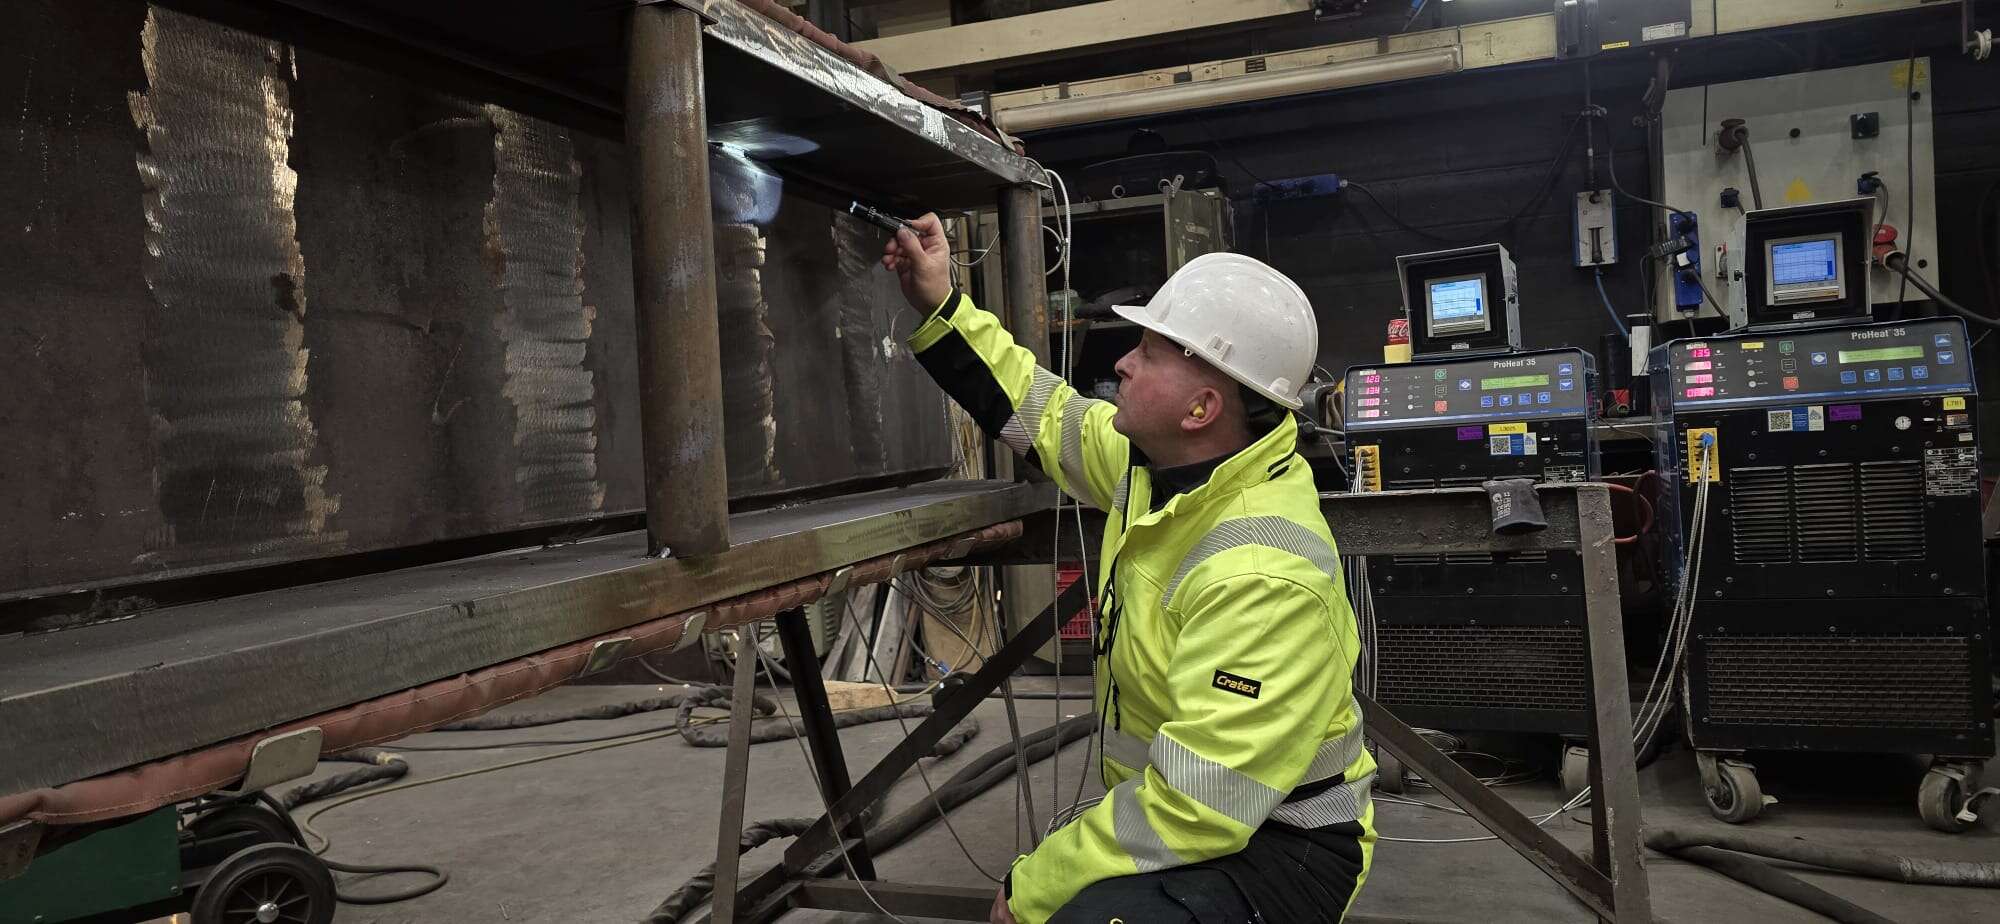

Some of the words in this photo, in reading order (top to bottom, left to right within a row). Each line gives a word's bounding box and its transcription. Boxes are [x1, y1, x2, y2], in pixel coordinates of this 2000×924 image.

[1851, 330, 1889, 340] ProHeat
[1893, 328, 1906, 337] 35
[1493, 360, 1524, 369] ProHeat
[1526, 358, 1536, 366] 35
[1216, 675, 1258, 694] Cratex
